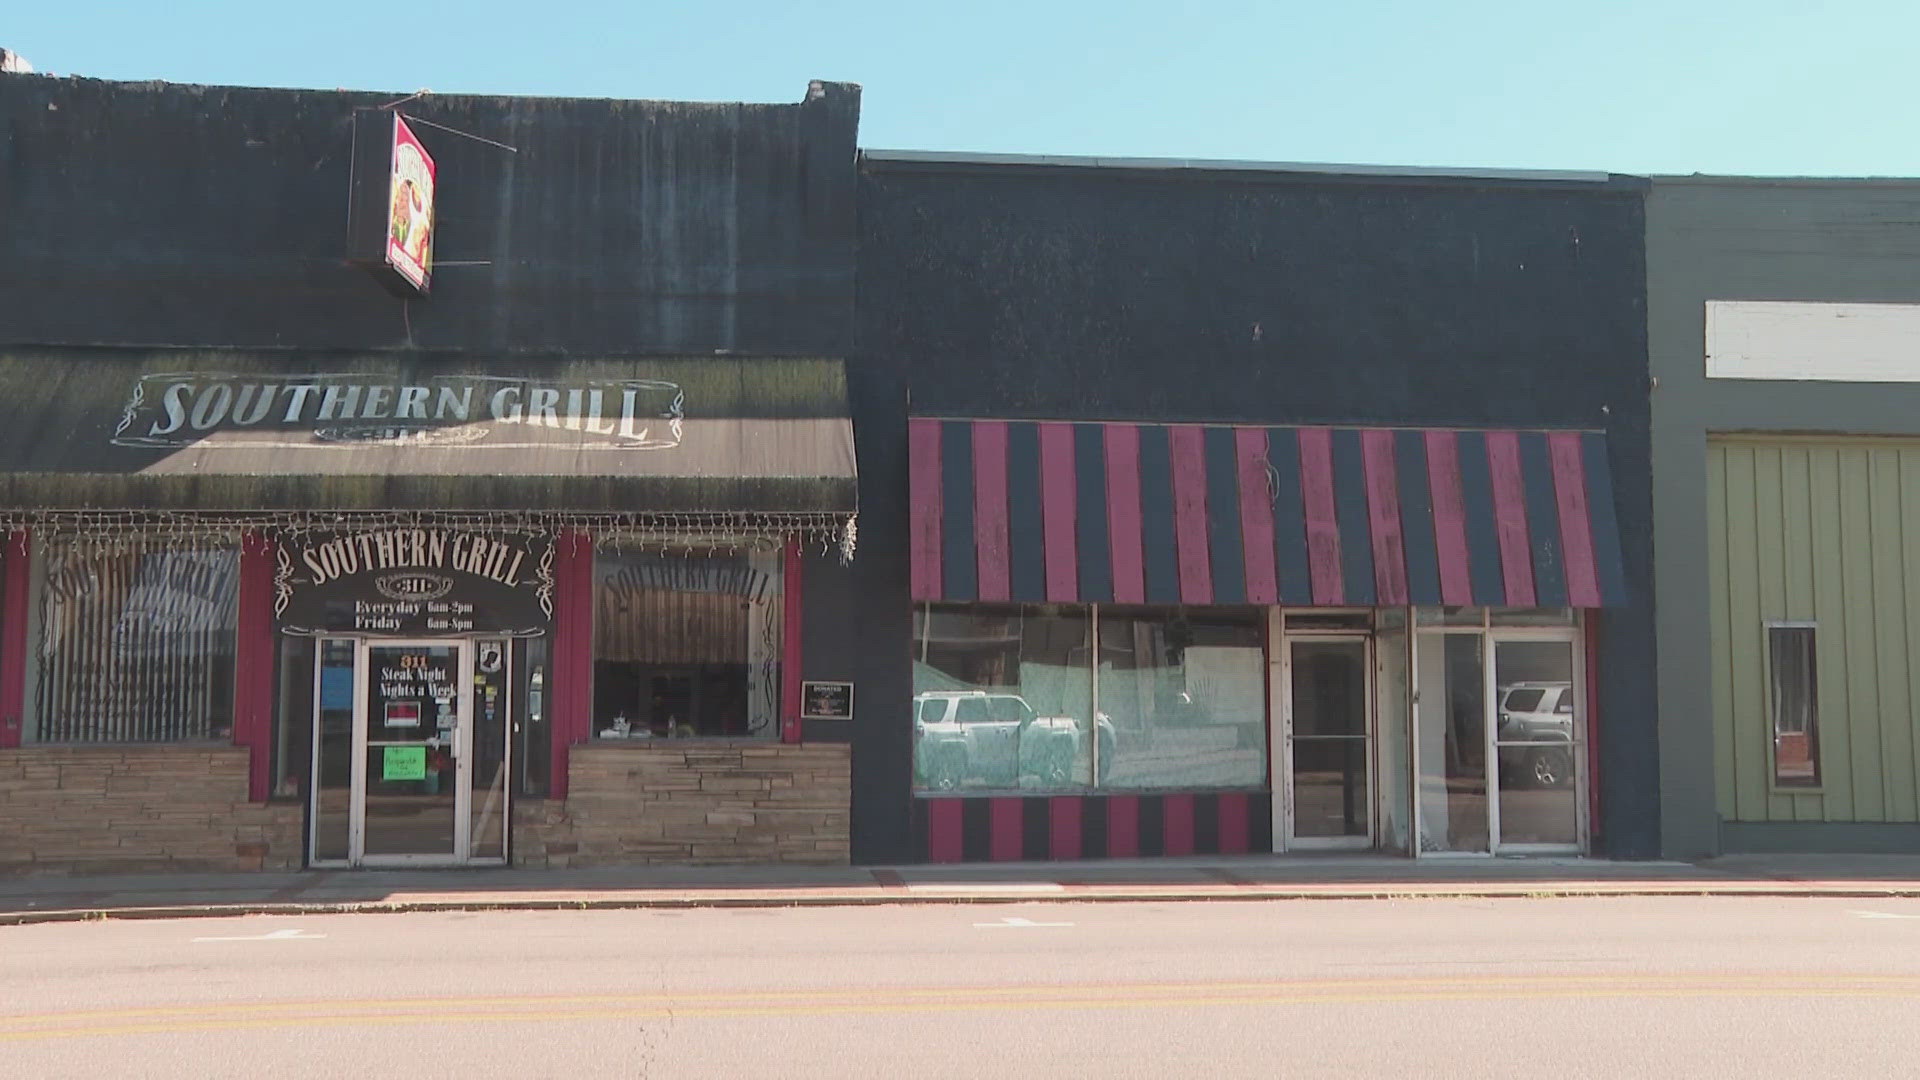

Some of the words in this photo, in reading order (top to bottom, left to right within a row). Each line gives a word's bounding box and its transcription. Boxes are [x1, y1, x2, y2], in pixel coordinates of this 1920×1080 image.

[149, 383, 474, 436] SOUTHERN
[490, 386, 649, 440] GRILL
[303, 528, 447, 586] SOUTHERN
[452, 533, 525, 588] GRILL
[401, 579, 426, 593] 311
[355, 601, 420, 616] Everyday
[427, 601, 473, 615] 6am-2pm
[355, 616, 402, 632] Friday
[381, 667, 413, 680] Steak
[417, 667, 446, 683] Night
[380, 682, 415, 699] Nights
[418, 686, 424, 696] a
[428, 682, 456, 697] Week
